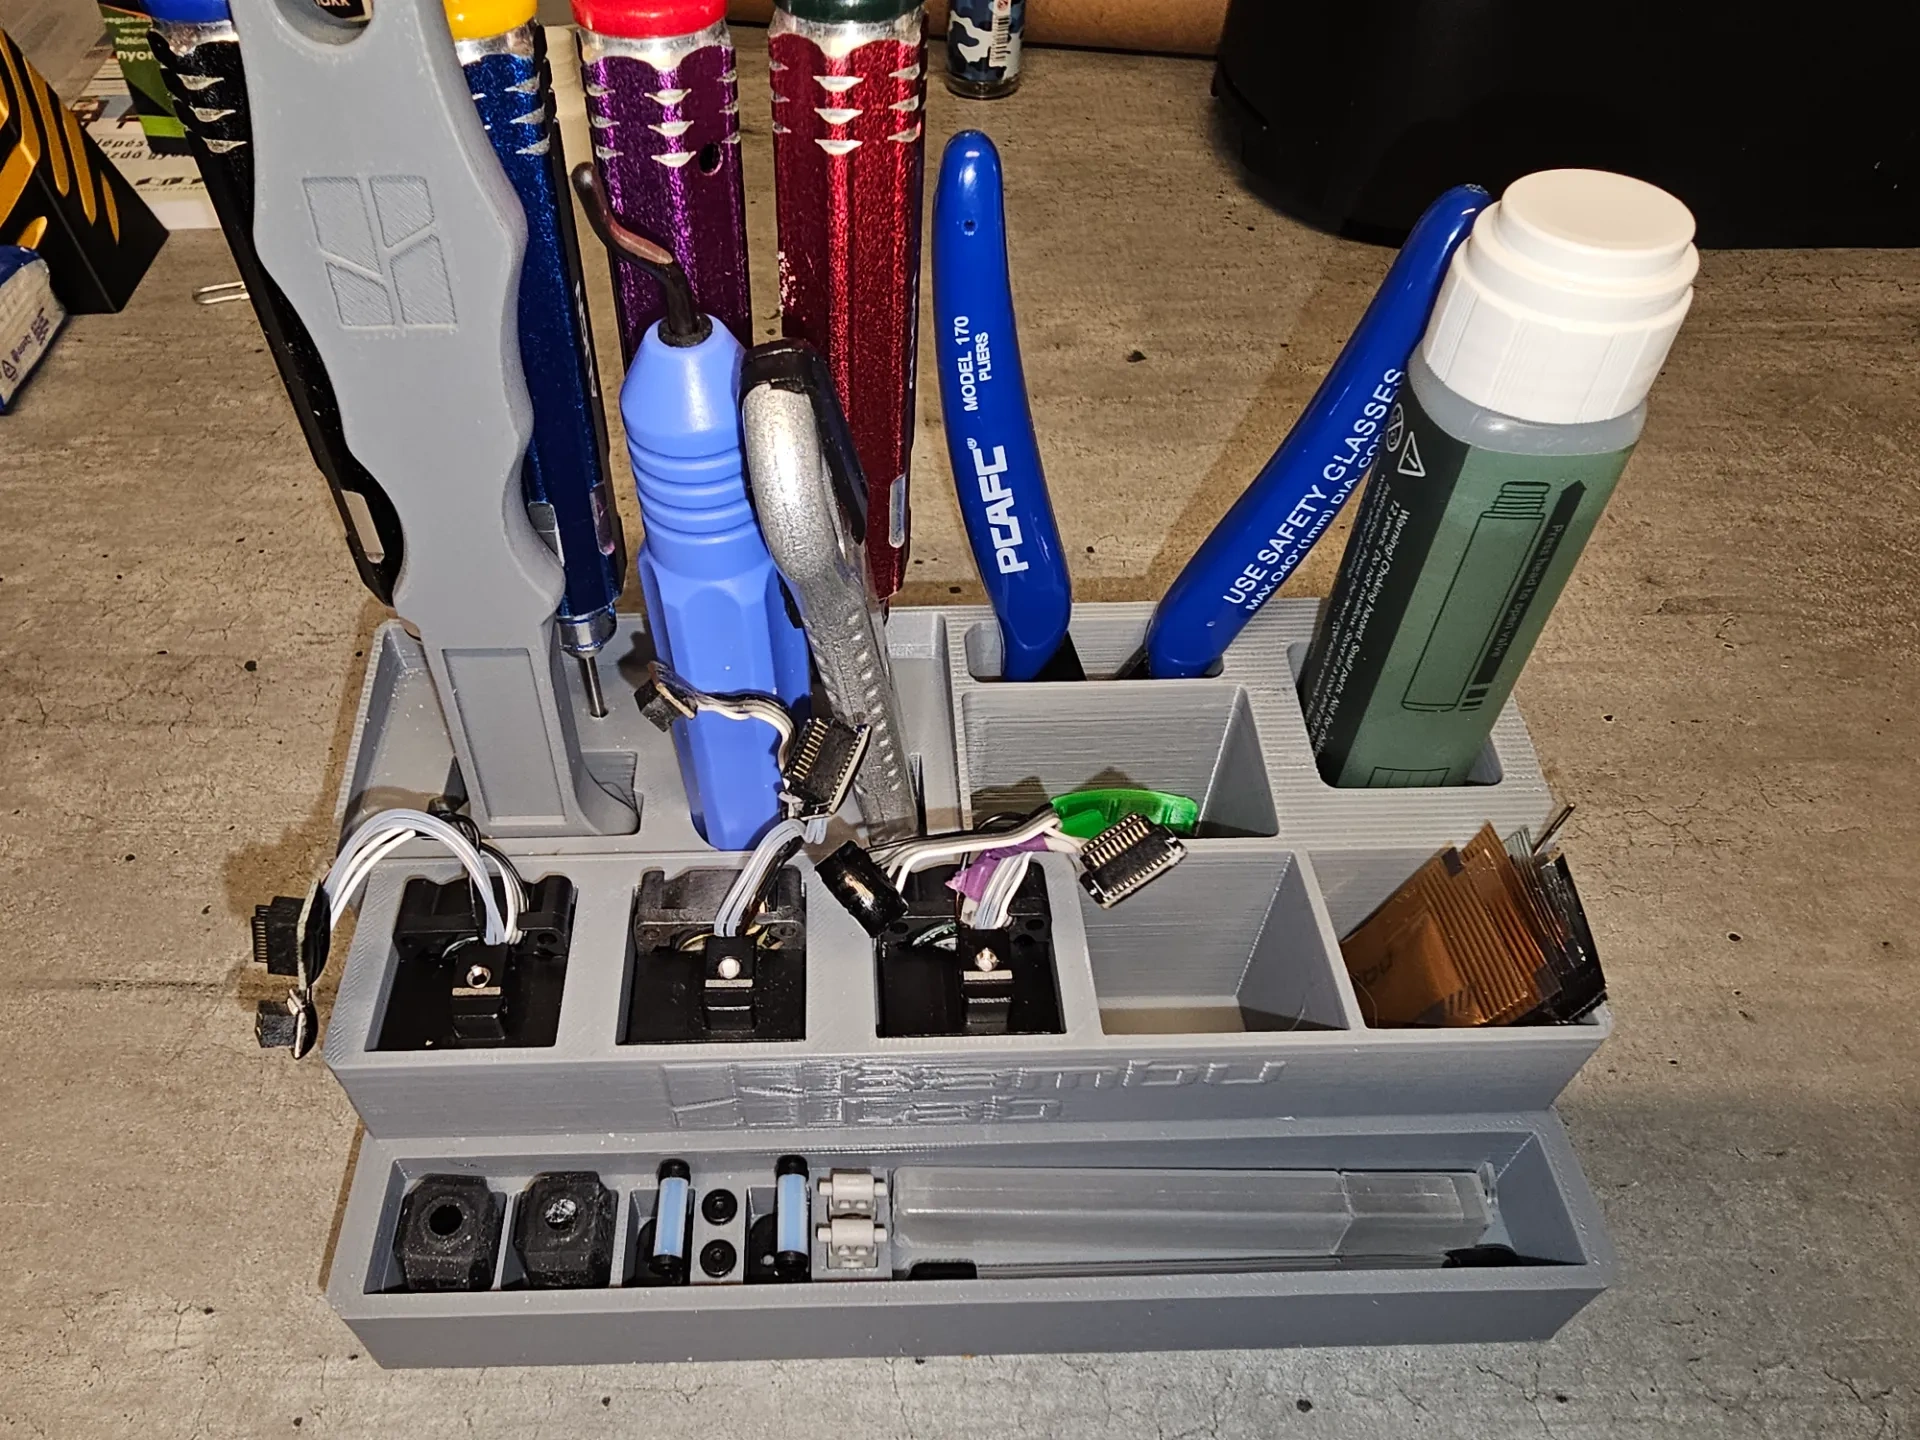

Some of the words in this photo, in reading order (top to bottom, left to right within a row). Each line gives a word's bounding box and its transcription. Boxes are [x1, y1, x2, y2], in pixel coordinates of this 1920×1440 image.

[954, 316, 970, 346] 170
[957, 350, 979, 412] MODEL
[975, 332, 992, 382] PLIERS
[1223, 564, 1268, 604] USE
[1257, 485, 1327, 565] SAFETY
[1323, 368, 1405, 481] GLASSES
[1384, 510, 1410, 561] Warning!
[1367, 560, 1391, 603] Choking
[1344, 642, 1359, 671] Small
